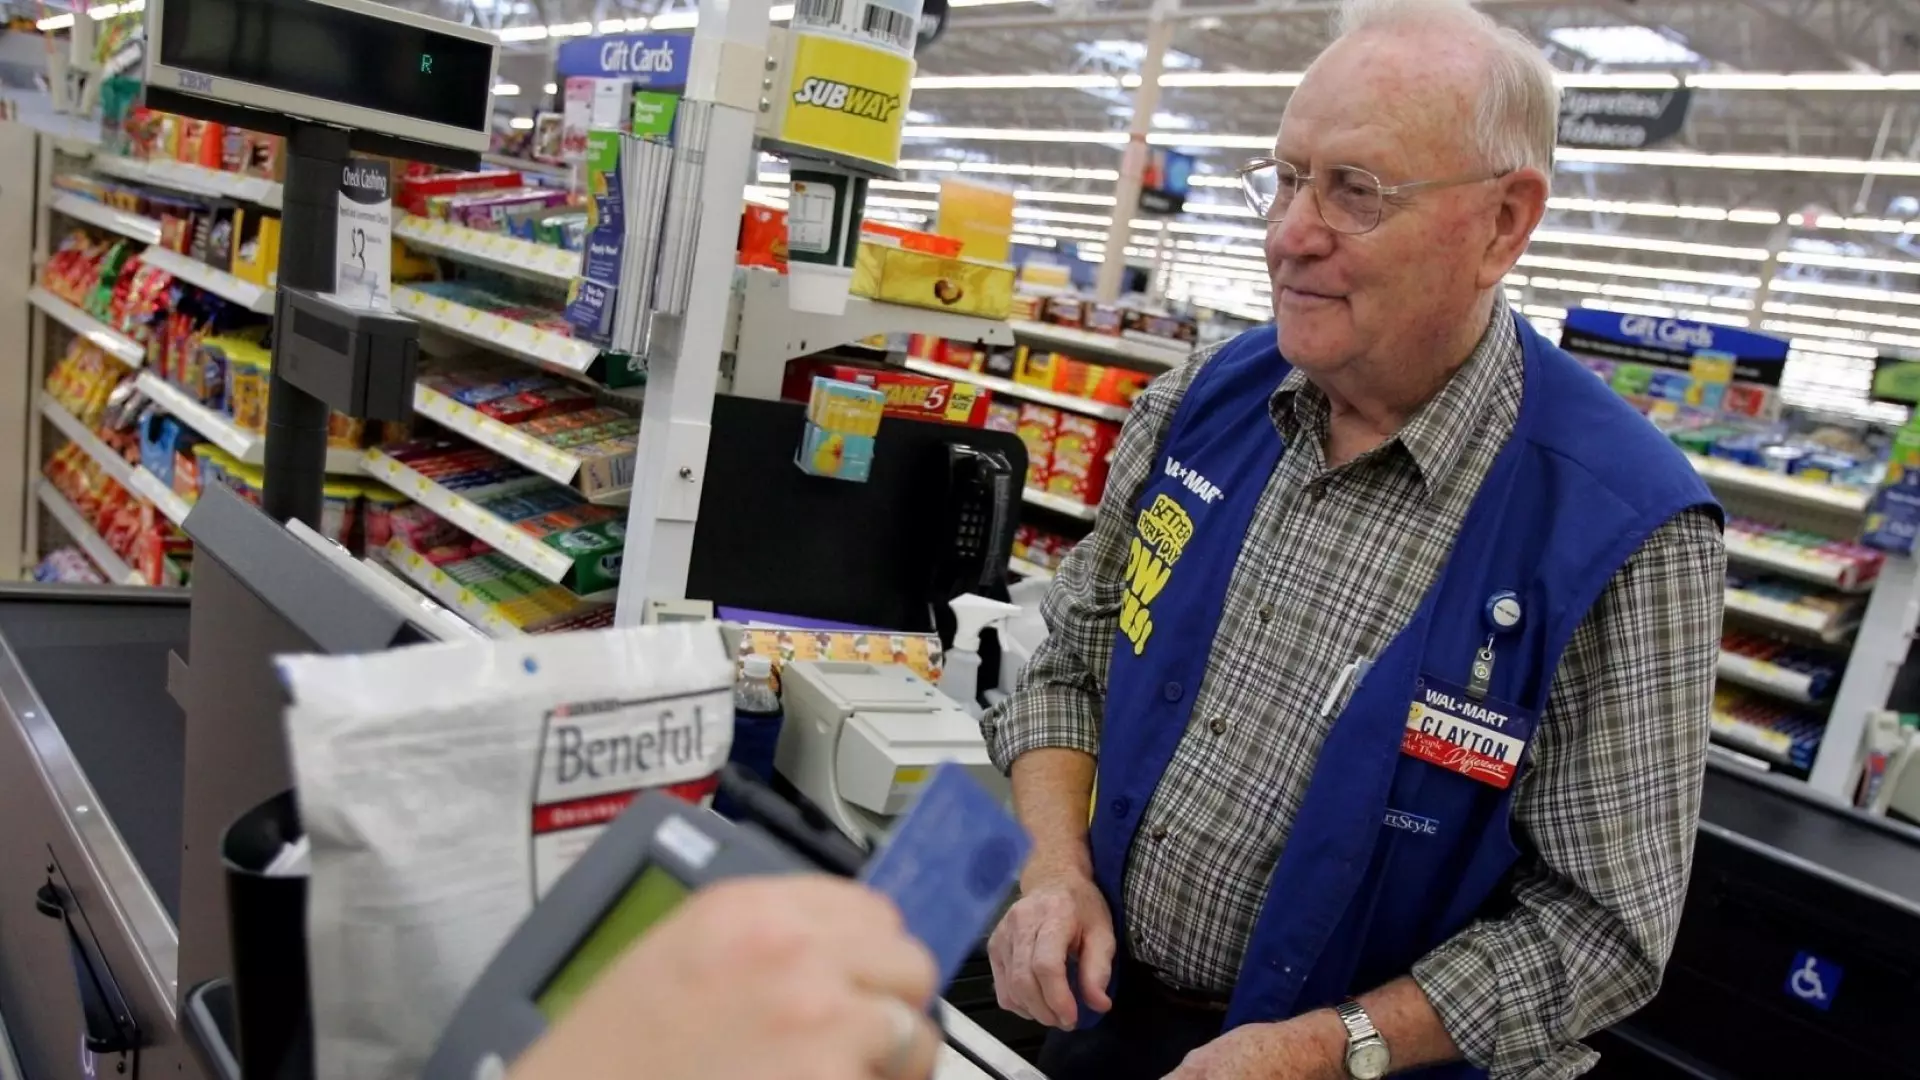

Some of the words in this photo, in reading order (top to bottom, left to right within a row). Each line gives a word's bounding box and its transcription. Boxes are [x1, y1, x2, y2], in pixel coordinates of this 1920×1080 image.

[420, 53, 433, 75] R
[601, 39, 629, 72] Gift
[630, 39, 674, 73] Cards
[178, 71, 213, 93] IBM
[794, 77, 899, 123] SUBWAY
[342, 165, 361, 187] Check
[361, 169, 387, 198] Cashing
[1619, 313, 1657, 340] Gift
[1657, 317, 1715, 349] Cards
[923, 384, 949, 410] 5
[1152, 498, 1191, 543] BETTER
[556, 705, 705, 785] Beneful
[1421, 715, 1509, 762] CLAYTON
[1444, 746, 1509, 778] Difference
